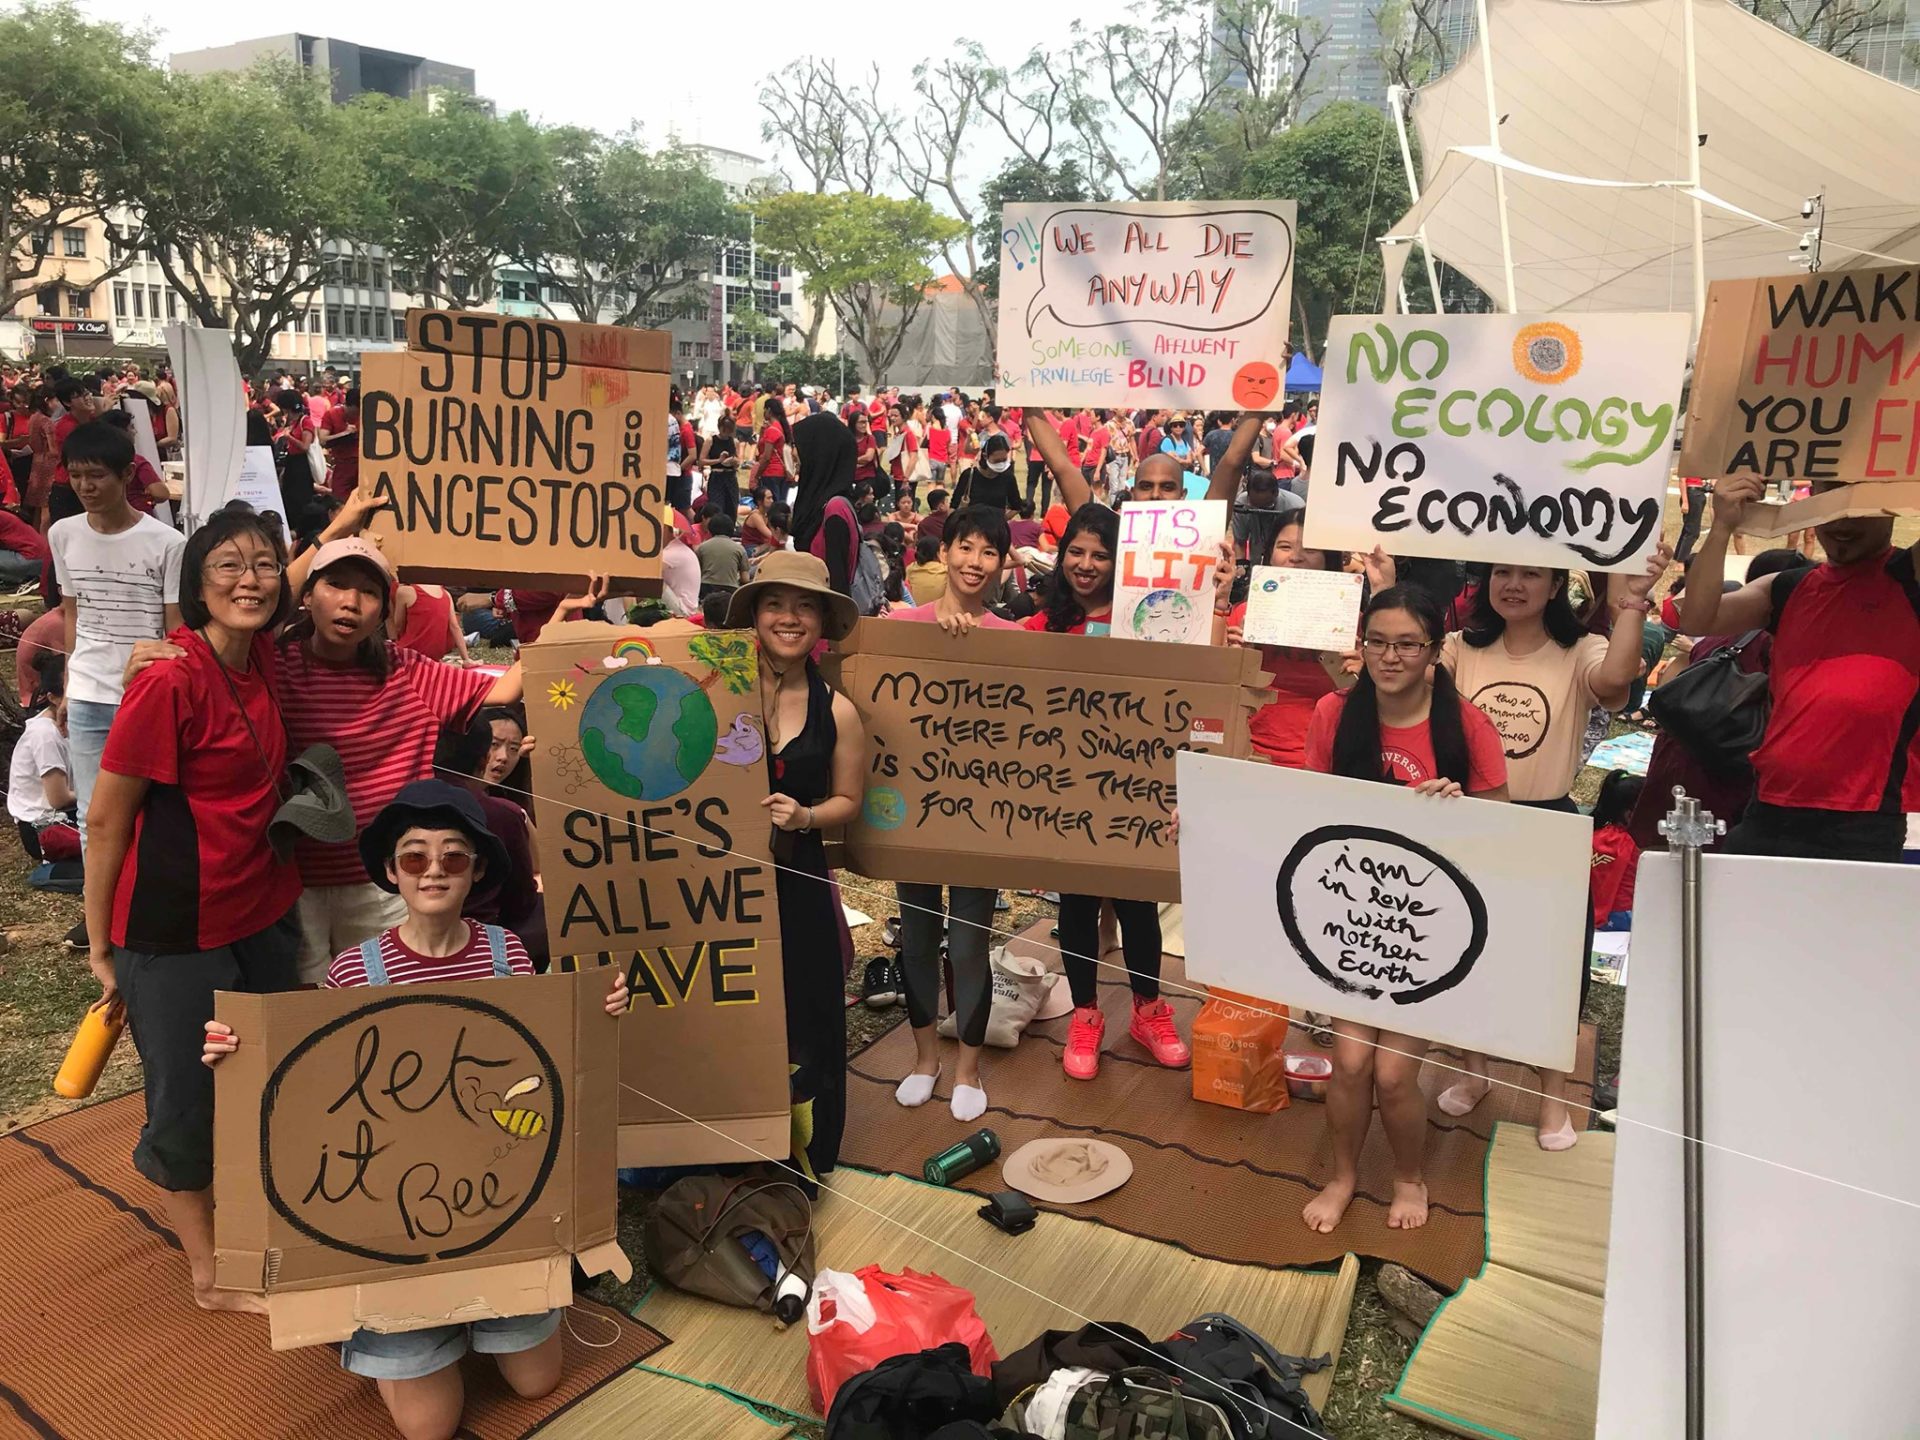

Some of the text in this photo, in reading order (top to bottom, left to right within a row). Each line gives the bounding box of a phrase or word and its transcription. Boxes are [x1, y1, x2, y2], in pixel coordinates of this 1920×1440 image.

[1053, 221, 1254, 259] WE ALL DIE
[1087, 266, 1236, 314] ANYWAY
[1767, 271, 1920, 329] WAK
[419, 313, 567, 401] STOP
[1154, 334, 1240, 360] AFFLUENT
[1346, 322, 1450, 384] NO
[1002, 370, 1023, 388] &
[361, 390, 594, 475] BURNING
[1391, 387, 1674, 474] ECOLOGY
[1738, 395, 1851, 435] YOU
[1865, 398, 1920, 478] E
[622, 410, 643, 478] OUR
[1335, 436, 1426, 486] NO
[1725, 439, 1842, 478] ARE
[362, 471, 662, 558] ANCESTORS
[1371, 473, 1660, 566] ECONOMY
[1122, 551, 1217, 591] LIT
[871, 670, 1034, 716] MOTHER
[1045, 685, 1154, 727] EARTH
[910, 713, 1009, 750] THERE
[1017, 724, 1066, 759] FOR
[561, 796, 733, 870] SHE'S
[916, 789, 987, 833] FOR
[990, 798, 1098, 847] MOTHER
[1318, 868, 1443, 916] in love
[1360, 856, 1439, 888] am
[560, 866, 766, 940] ALL WE
[1347, 909, 1430, 943] with
[993, 988, 1020, 1002] valid
[1338, 950, 1427, 986] Earth
[327, 1024, 517, 1128] let
[302, 1119, 520, 1241] it Bee
